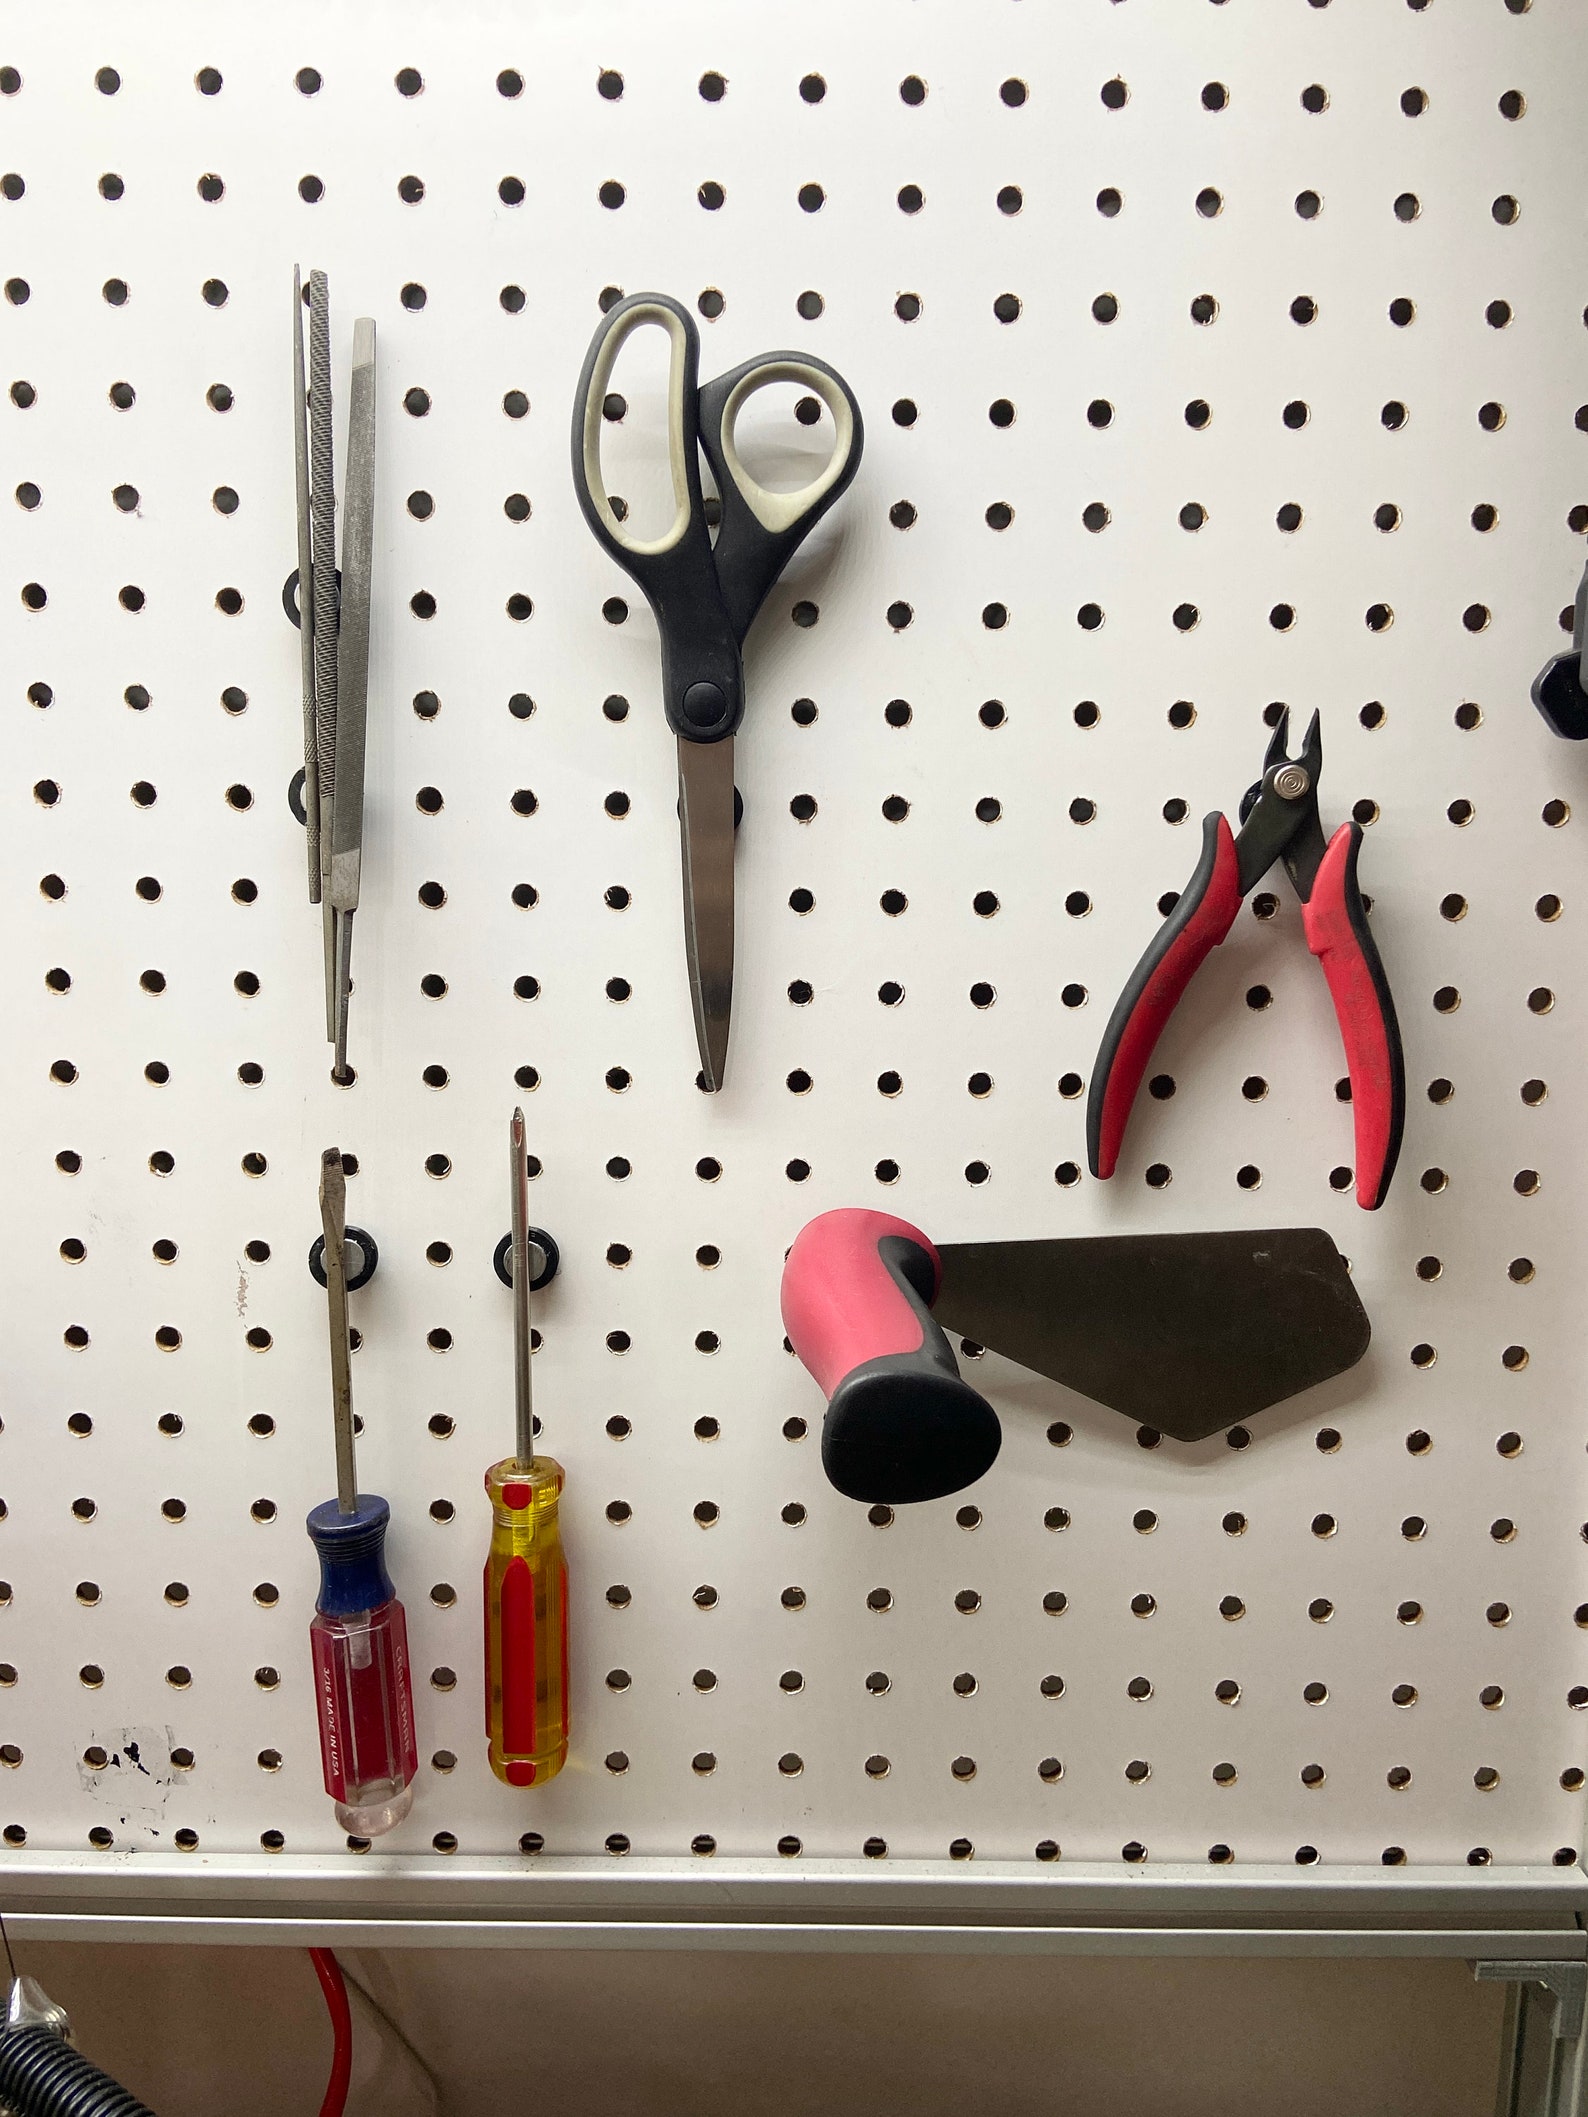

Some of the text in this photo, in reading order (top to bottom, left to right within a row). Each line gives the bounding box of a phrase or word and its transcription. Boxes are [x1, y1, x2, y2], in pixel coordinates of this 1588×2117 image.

[326, 1696, 336, 1732] MADE
[396, 1646, 410, 1753] CRAFTSMAN
[330, 1734, 337, 1748] IN
[332, 1751, 340, 1776] USA
